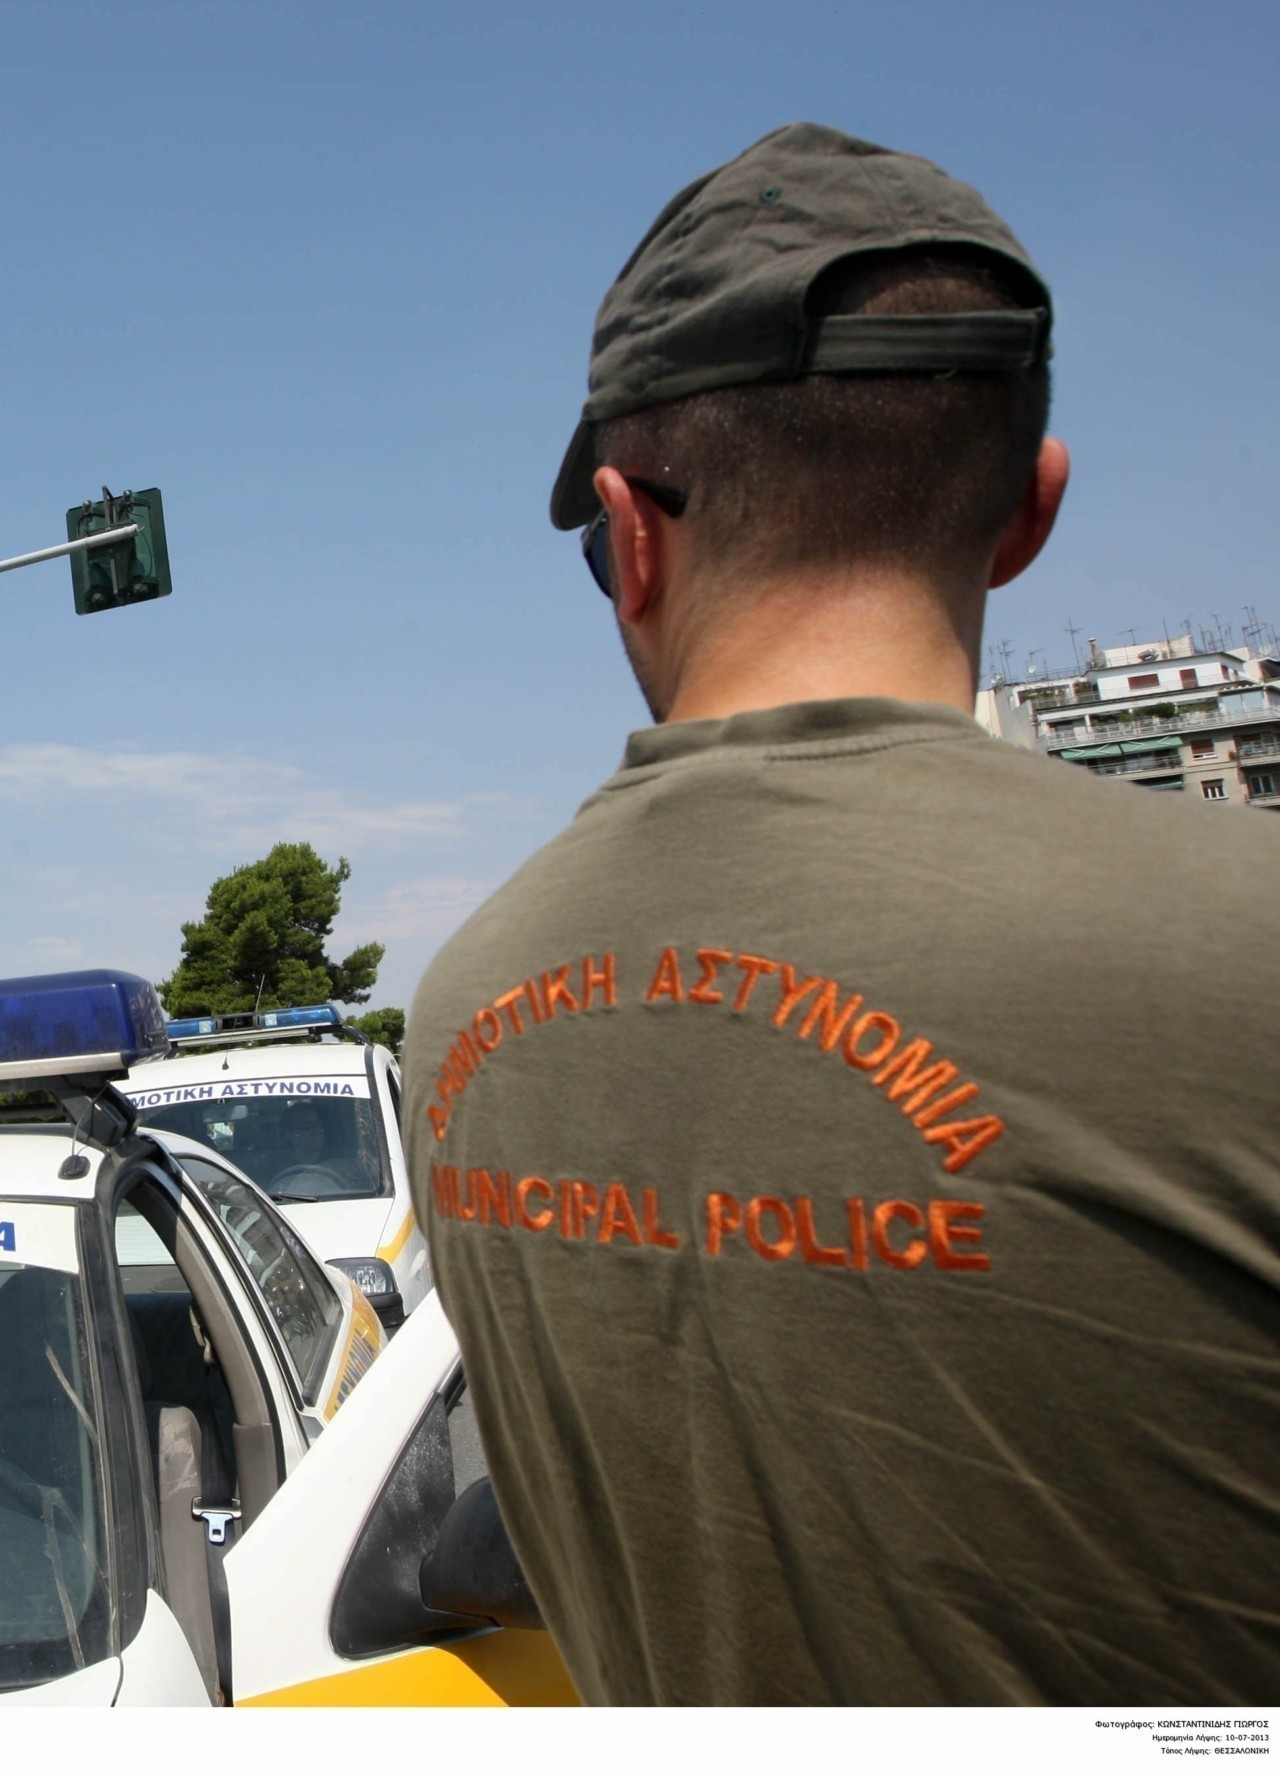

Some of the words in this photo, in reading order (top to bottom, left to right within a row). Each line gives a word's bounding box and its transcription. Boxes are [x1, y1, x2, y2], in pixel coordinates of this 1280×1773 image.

[130, 1086, 213, 1109] ΜΟΤΙΚΗ
[221, 1081, 355, 1097] ΑΣΤΥΝΟΜΙΑ
[427, 953, 617, 1142] ΔΗΜΟΤΙΚΗ
[646, 947, 1005, 1174] ΑΣΤΥΝΟΜΙΑ
[430, 1163, 681, 1249] MUNICIPAL
[705, 1193, 991, 1273] POLICE
